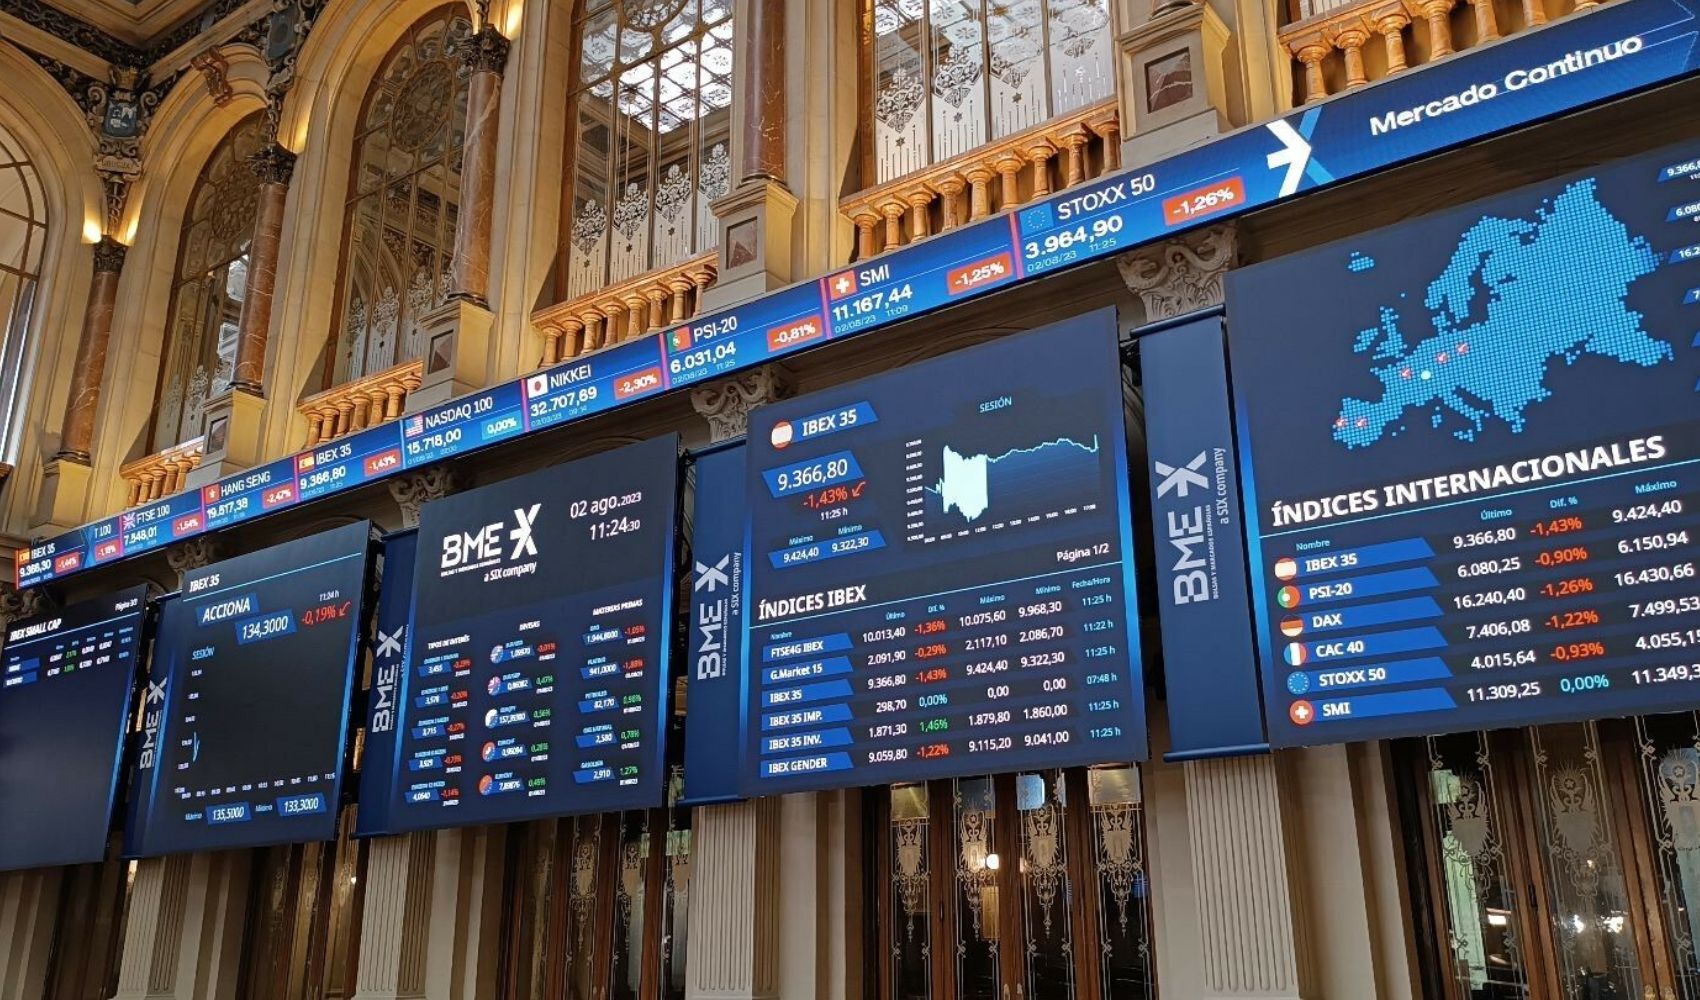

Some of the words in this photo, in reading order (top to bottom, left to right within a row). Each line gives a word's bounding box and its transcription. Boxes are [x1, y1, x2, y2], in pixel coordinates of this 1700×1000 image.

[1370, 81, 1497, 136] Mercado
[1504, 36, 1642, 90] Continuo
[1057, 183, 1126, 221] STOXX
[1130, 174, 1155, 196] 50
[1025, 215, 1123, 259] 3.964,90
[1174, 187, 1234, 215] -1,26%
[860, 264, 889, 286] SMI
[1027, 251, 1077, 272] 02/08/23
[833, 284, 913, 321] 11.167,44
[955, 262, 1005, 285] -1,25%
[694, 316, 737, 342] PSI-20
[670, 342, 736, 373] 6.031,04
[774, 323, 816, 342] -0,81%
[550, 364, 591, 388] NIKKEI
[426, 404, 471, 428] NASDAQ
[474, 397, 493, 413] 100
[530, 387, 597, 417] 32.707,69
[619, 375, 657, 393] -2,30%
[980, 396, 1012, 413] SESIÓN
[407, 429, 461, 454] 15.718,00
[487, 417, 517, 434] 0,00%
[802, 415, 836, 437] IBEX
[840, 409, 857, 426] 35
[316, 448, 338, 465] IBEX
[340, 443, 351, 457] 35
[1213, 448, 1227, 495] company
[221, 480, 244, 496] HANG
[246, 471, 270, 488] SENG
[778, 459, 848, 491] 9.366,80
[1272, 489, 1378, 527] ÍNDICES
[1384, 435, 1667, 506] INTERNACIONALES
[137, 509, 155, 524] FTSE
[157, 505, 170, 517] 100
[571, 500, 587, 519] 02
[590, 492, 642, 516] ago.2023
[803, 488, 847, 507] -1,43%
[820, 509, 841, 520] 11:25
[842, 507, 848, 516] h
[1216, 497, 1228, 517] SIX
[1480, 507, 1512, 521] Último
[1635, 479, 1677, 495] Máximo
[441, 522, 503, 568] BME
[590, 517, 640, 540] 11:24:30
[1296, 538, 1330, 550] Nombre
[1305, 557, 1338, 573] IBEX
[1340, 553, 1357, 566] 35
[1453, 527, 1516, 549] 9.366,80
[1530, 516, 1582, 537] -1,43%
[1612, 500, 1681, 525] 9.424,40
[31, 546, 46, 559] IBEX
[783, 547, 819, 563] 9.424,40
[832, 537, 868, 553] 9.322,30
[1056, 547, 1090, 562] Página
[1092, 543, 1109, 555] 1/2
[1168, 506, 1209, 605] BME
[1309, 582, 1352, 600] PSI-20
[1457, 556, 1520, 578] 6.080,25
[1535, 546, 1587, 566] -0,90%
[1618, 530, 1688, 555] 6.150,94
[189, 577, 208, 592] IBEX
[209, 574, 220, 587] 35
[484, 572, 489, 582] a
[491, 568, 502, 580] SIX
[503, 562, 537, 578] company
[732, 552, 741, 592] company
[203, 597, 250, 622] ACCIONA
[731, 593, 739, 608] SIX
[758, 592, 824, 621] ÍNDICES
[828, 584, 867, 608] IBEX
[1313, 613, 1342, 628] DAX
[1453, 586, 1525, 610] 16.240,40
[1540, 578, 1592, 597] -1,26%
[1614, 563, 1695, 587] 16.430,66
[243, 616, 288, 640] 134,3000
[302, 605, 336, 625] -0,19%
[803, 640, 824, 653] IBEX
[863, 627, 905, 643] 10.013,40
[914, 620, 946, 634] -1,36%
[959, 610, 1006, 627] 10.075,60
[1019, 601, 1062, 618] 9.968,30
[1082, 596, 1104, 606] 11:25
[1106, 594, 1112, 603] h
[1316, 643, 1343, 657] CAC
[1347, 641, 1364, 654] 40
[1466, 618, 1530, 640] 7.406,08
[1545, 609, 1598, 628] -1,22%
[1629, 594, 1700, 618] 7.499,53
[698, 600, 721, 680] BME
[770, 666, 812, 680] G.Market
[813, 664, 822, 674] 15
[868, 651, 906, 665] 2.091,90
[915, 644, 946, 658] -0,29%
[966, 634, 1007, 651] 2.117,10
[1019, 626, 1063, 643] 2.086,70
[1084, 622, 1106, 631] 11:22
[1107, 620, 1113, 628] h
[770, 692, 790, 703] IBEX
[791, 690, 802, 700] 35
[868, 675, 906, 689] 9.366,80
[915, 668, 946, 683] -1,43%
[966, 660, 1008, 676] 9.424,40
[1021, 651, 1065, 668] 9.322,30
[1085, 648, 1107, 657] 11:25
[1109, 646, 1115, 654] h
[1319, 670, 1366, 687] STOXX
[1368, 667, 1386, 681] 50
[1471, 649, 1536, 670] 4.015,64
[1550, 641, 1604, 660] -0,93%
[372, 665, 395, 732] BME
[769, 714, 790, 727] IBEX
[791, 712, 802, 723] 35
[804, 711, 822, 722] IMP.
[876, 700, 907, 713] 298,70
[919, 694, 947, 708] 0,00%
[987, 686, 1009, 699] 0,00
[1043, 678, 1066, 692] 0,00
[1087, 674, 1109, 685] 07:48
[1111, 673, 1117, 681] h
[1323, 702, 1350, 717] SMI
[1467, 682, 1540, 702] 11.309,25
[1560, 674, 1609, 692] 0,00%
[140, 710, 159, 769] BME
[769, 738, 790, 750] IBEX
[791, 736, 801, 748] 35
[803, 734, 821, 746] INV.
[869, 723, 907, 738] 1.871,30
[919, 719, 948, 732] 1,46%
[969, 710, 1010, 726] 1.879,80
[1024, 704, 1068, 720] 1.860,00
[1089, 702, 1111, 711] 11:25
[1113, 700, 1119, 709] h
[769, 762, 790, 774] IBEX
[791, 758, 827, 771] GENDER
[869, 749, 907, 763] 9.059,80
[917, 744, 949, 757] -1,22%
[969, 737, 1011, 752] 9.115,20
[1024, 731, 1069, 747] 9.041,00
[1090, 729, 1113, 738] 11:25
[1115, 727, 1121, 736] h
[213, 807, 245, 820] 135,5000
[284, 798, 318, 813] 133,3000
